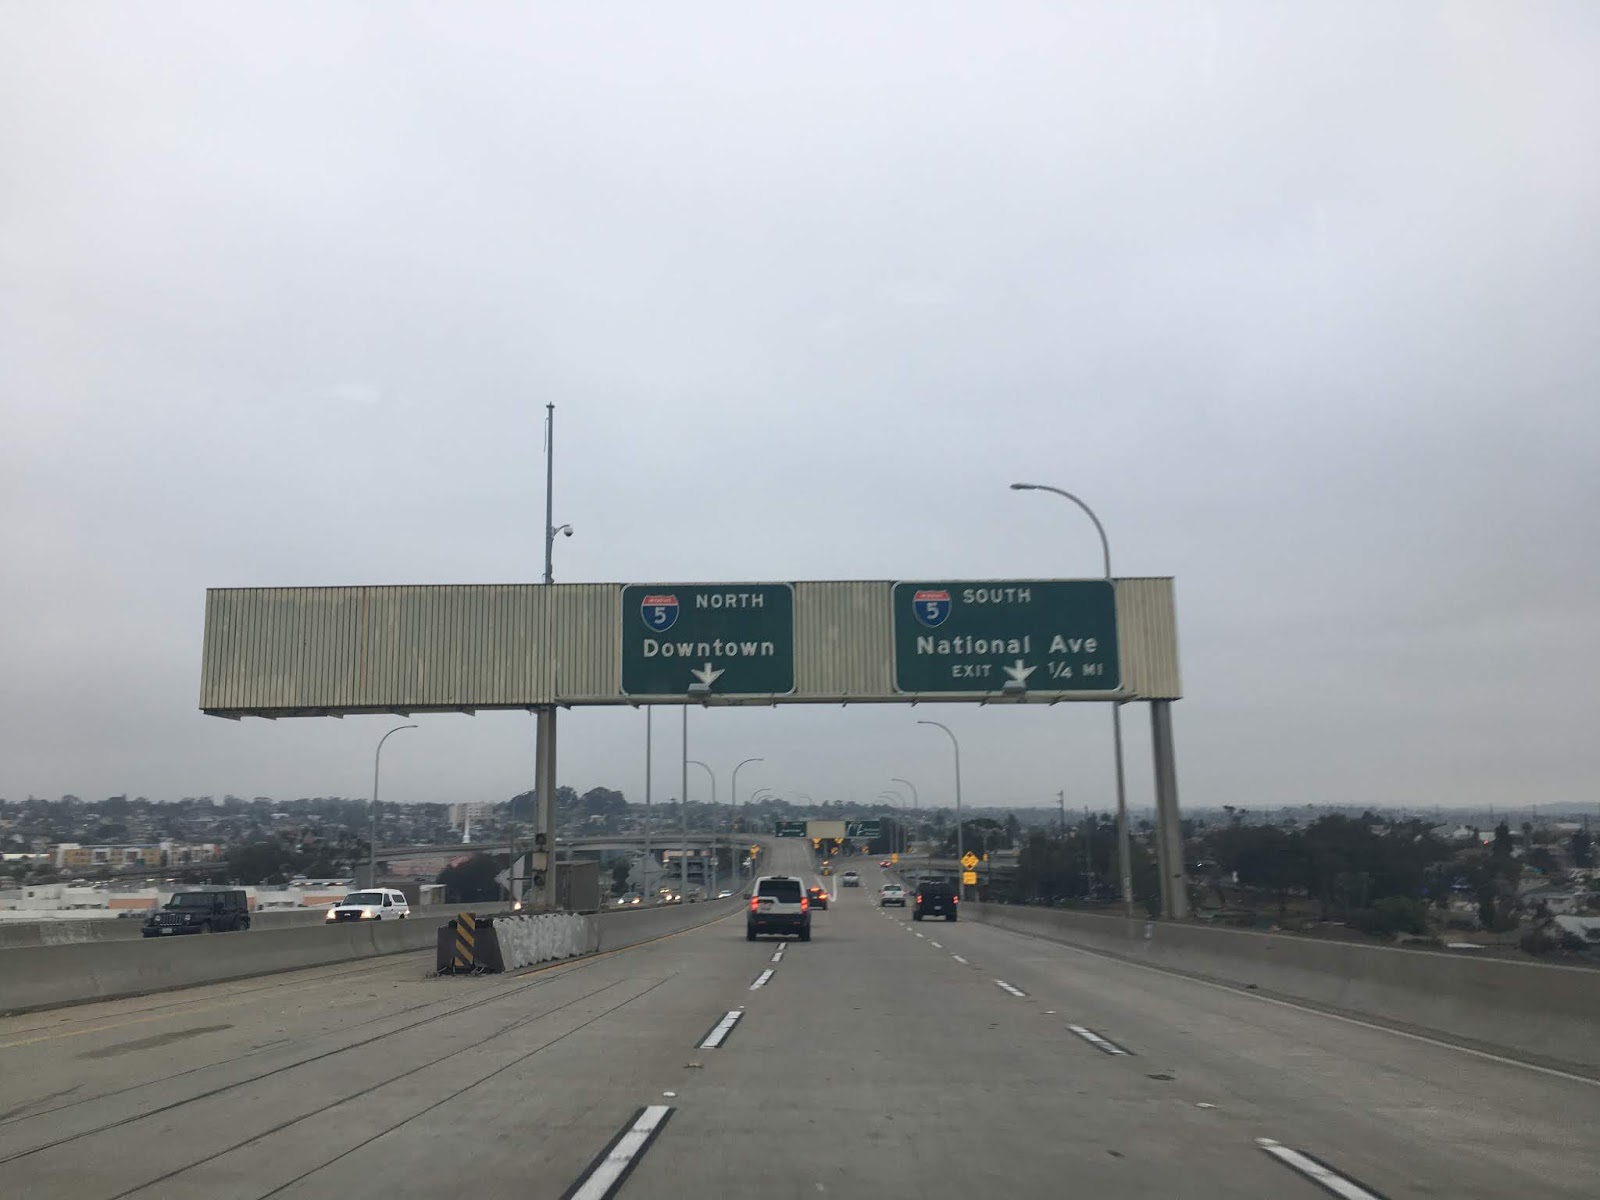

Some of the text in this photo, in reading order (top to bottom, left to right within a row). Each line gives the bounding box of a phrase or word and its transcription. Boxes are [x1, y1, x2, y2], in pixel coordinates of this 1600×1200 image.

[696, 593, 763, 608] NORTH
[962, 588, 1031, 604] SOUTH
[654, 606, 666, 624] 5
[926, 601, 940, 620] 5
[643, 638, 774, 657] Downtown
[916, 634, 1098, 655] National Ave
[952, 664, 992, 678] EXIT
[1082, 663, 1104, 676] MI
